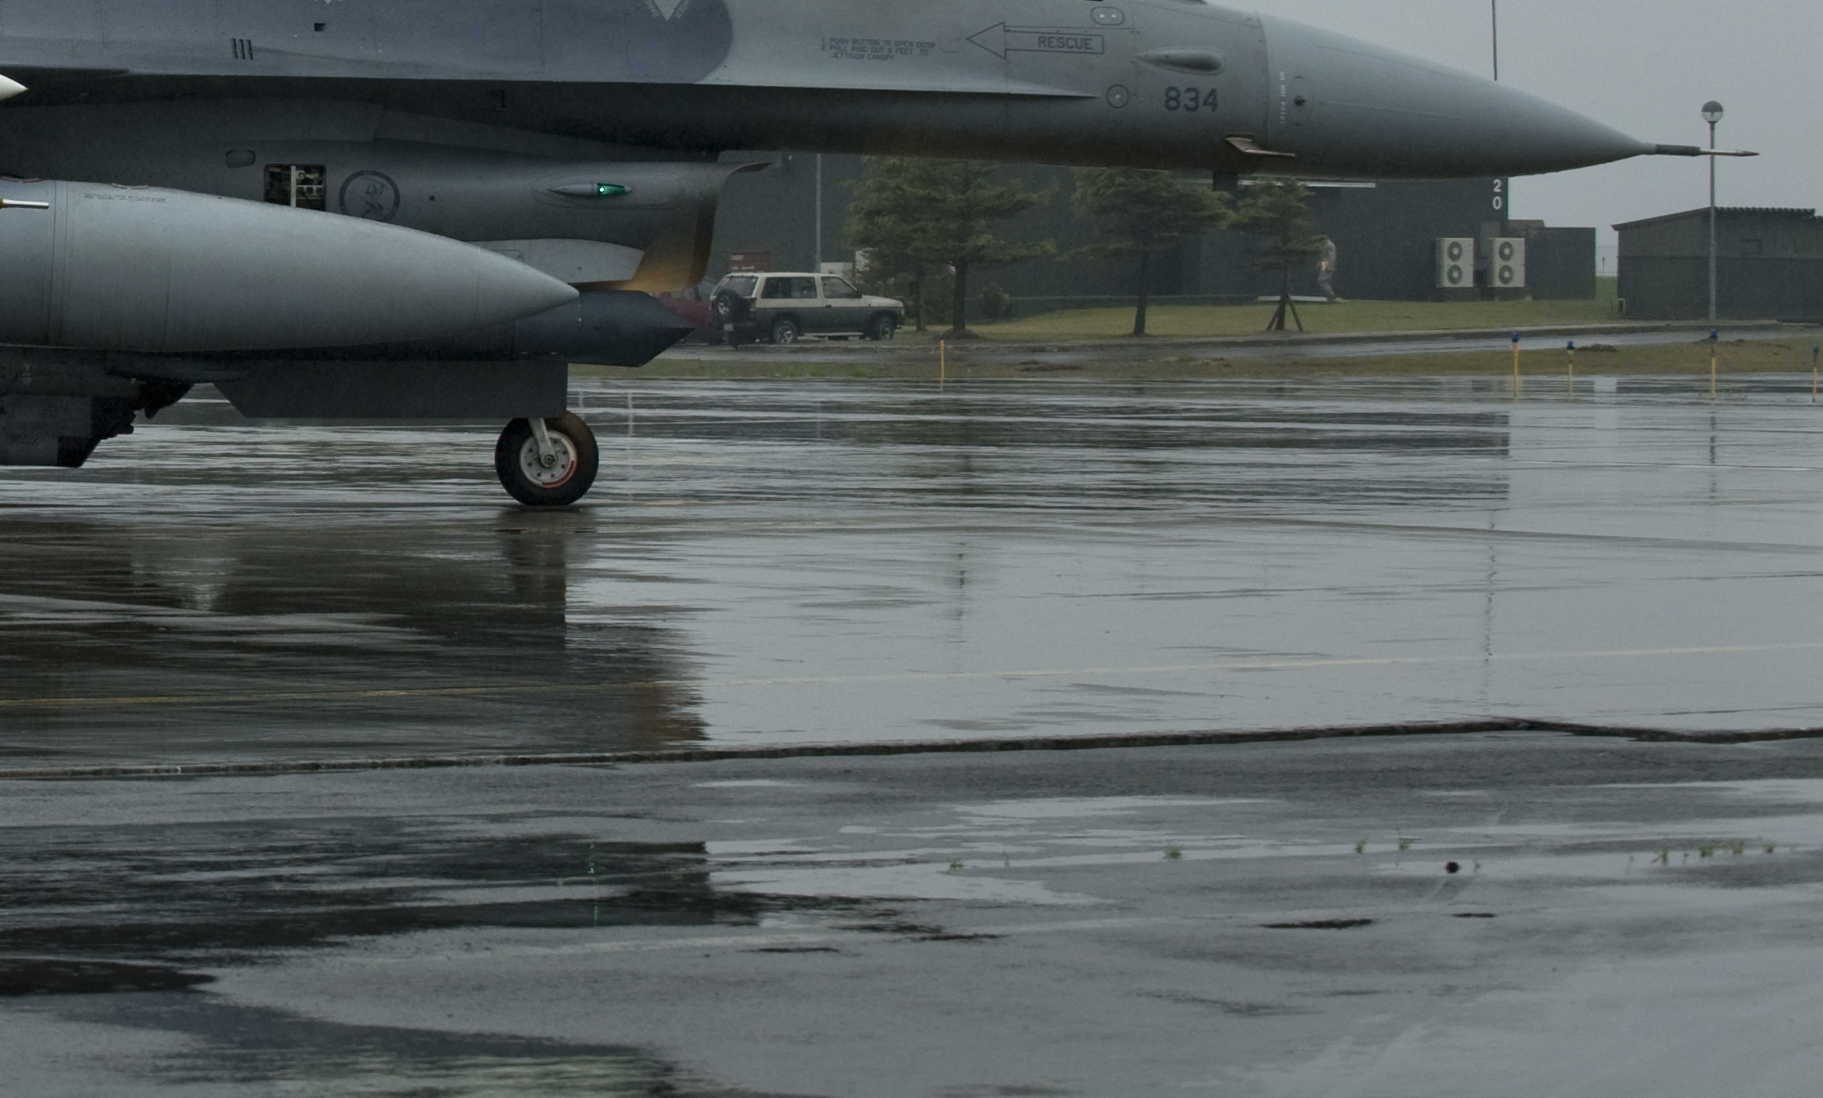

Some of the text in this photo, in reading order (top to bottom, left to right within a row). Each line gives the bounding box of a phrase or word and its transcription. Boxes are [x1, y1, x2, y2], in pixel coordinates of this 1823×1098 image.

[851, 38, 880, 46] BUTTON
[1036, 35, 1093, 51] RESCUE
[1164, 86, 1219, 112] 834
